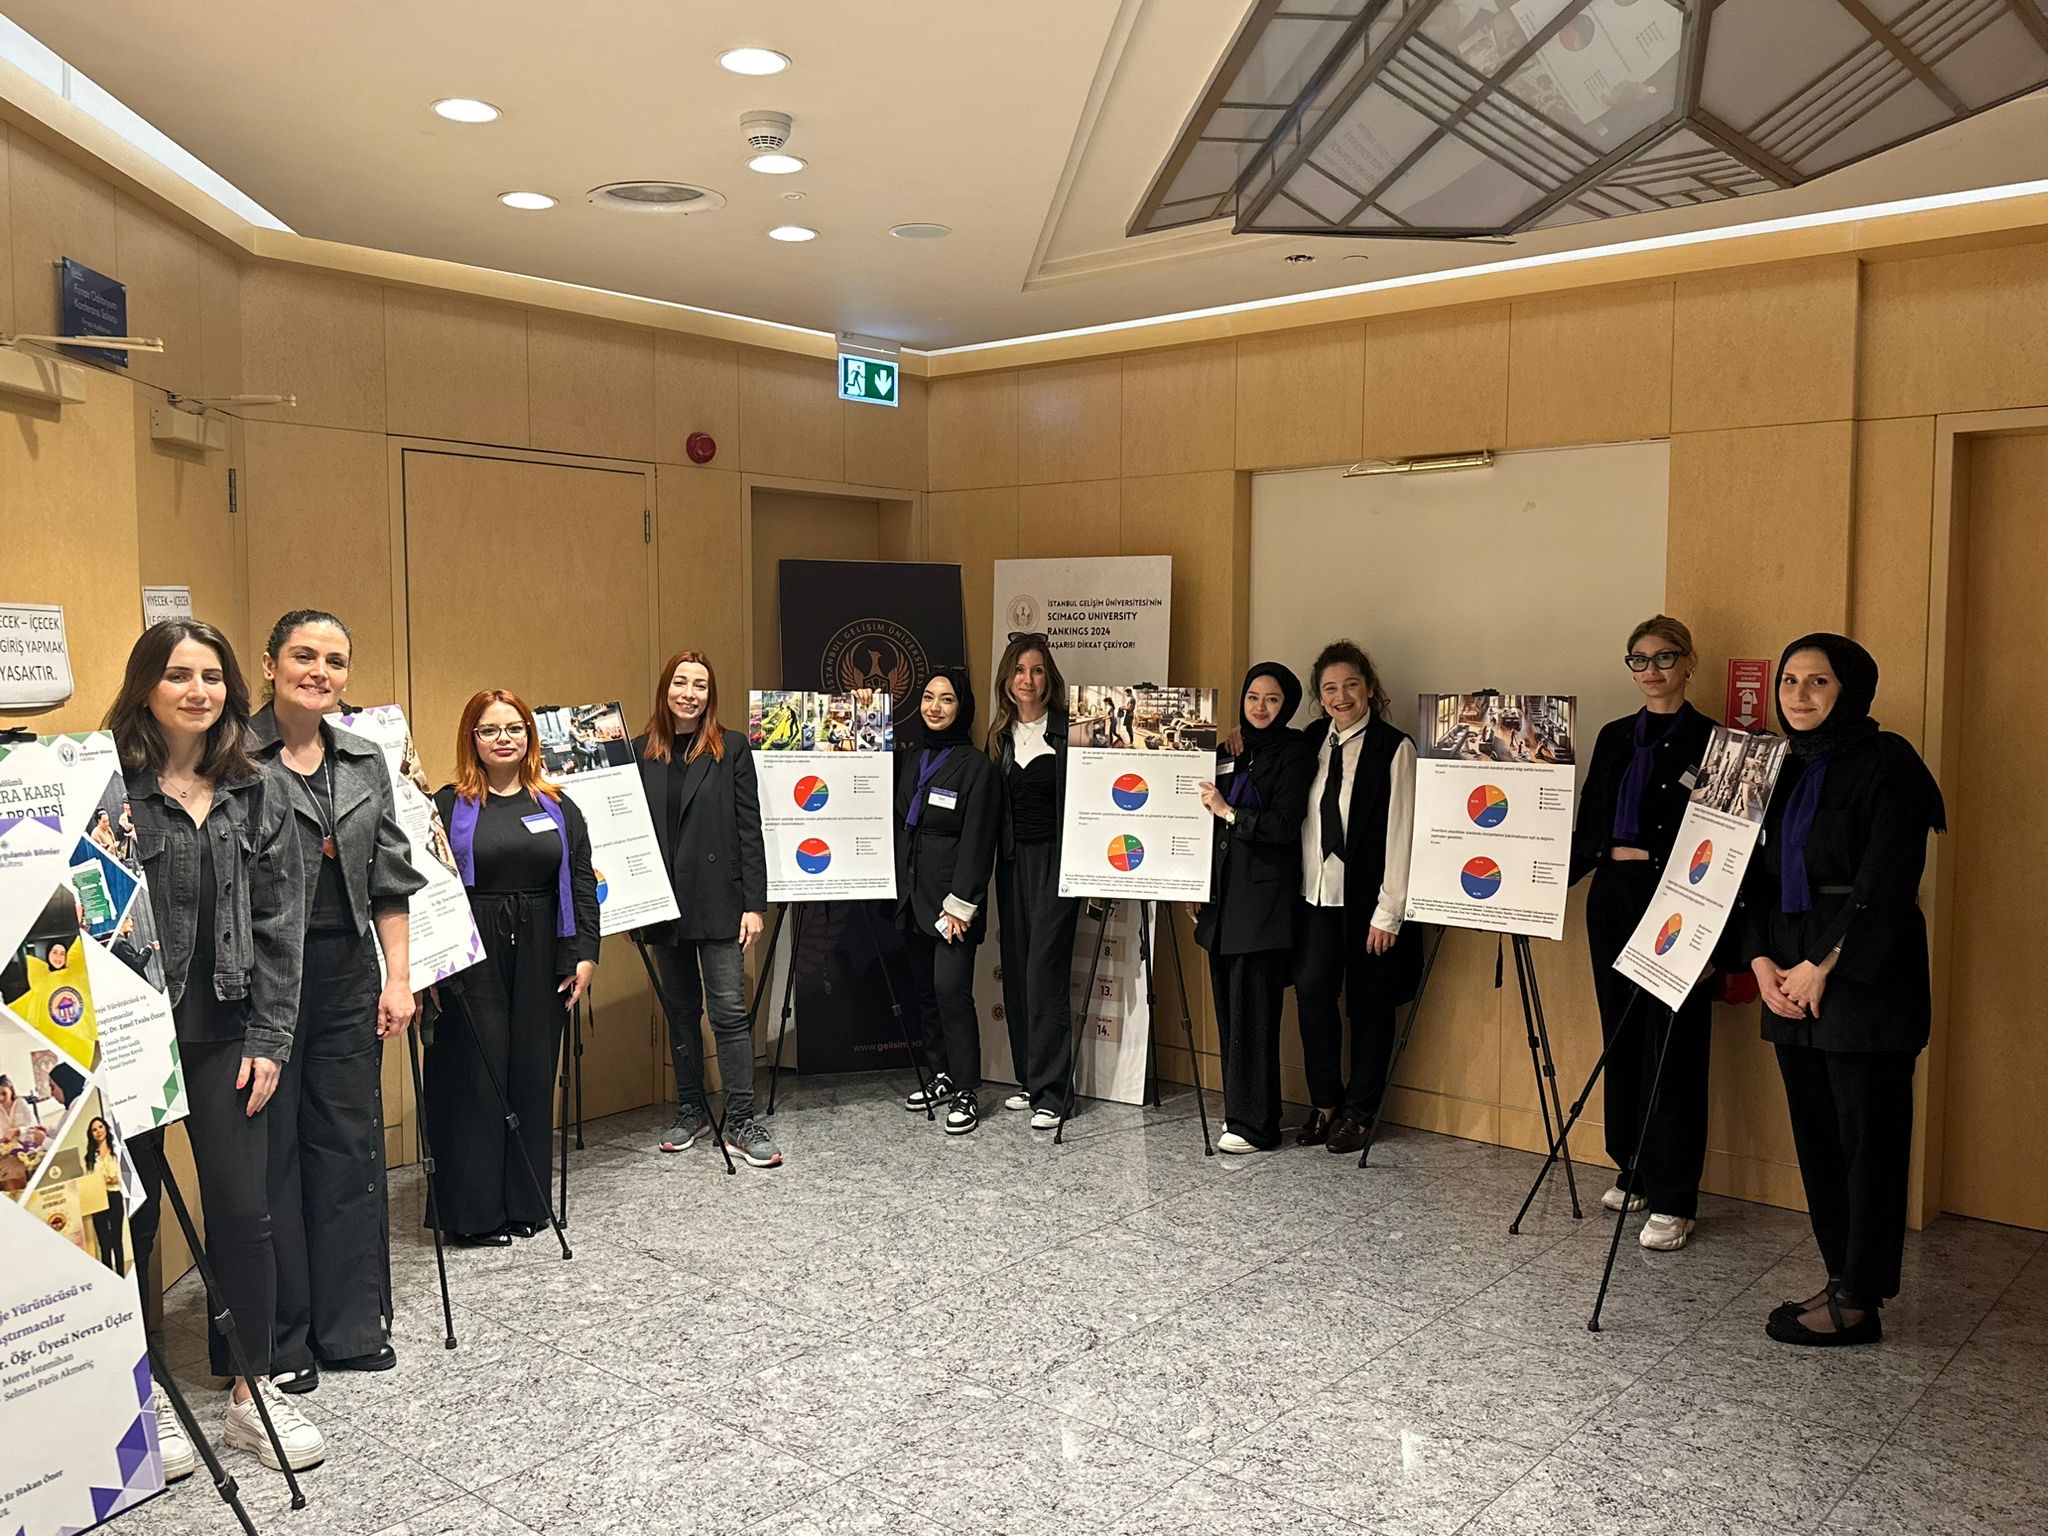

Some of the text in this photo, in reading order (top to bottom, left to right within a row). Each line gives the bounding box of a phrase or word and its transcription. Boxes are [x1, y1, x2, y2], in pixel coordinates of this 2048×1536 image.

[1047, 598, 1078, 608] İSTANBUL
[1079, 598, 1103, 609] GELİŞİM
[29, 613, 60, 633] İÇECEK
[1047, 611, 1138, 621] SCIMAGO UNIVERSITY
[1047, 626, 1111, 636] RANKINGS 2024
[0, 637, 65, 656] GİRİŞ YAPMAK
[1077, 640, 1102, 649] DİKKAT
[1103, 640, 1136, 651] ÇEKİYOR!
[825, 641, 843, 690] İSTANBUL
[844, 622, 885, 639] GELİŞİM
[0, 665, 58, 681] YASAKTIR.
[0, 783, 66, 804] RA KARŞI
[1104, 946, 1113, 957] 8.
[1100, 985, 1113, 997] 13.
[1097, 1024, 1110, 1037] 14.
[12, 1285, 78, 1318] Yürütücüsü
[79, 1281, 93, 1292] ve
[10, 1348, 38, 1367] Öğr.
[38, 1336, 70, 1356] Üyesi
[71, 1322, 104, 1342] Nevra
[104, 1310, 134, 1330] Üçler
[2, 1371, 31, 1387] Merve
[3, 1383, 37, 1401] Selman
